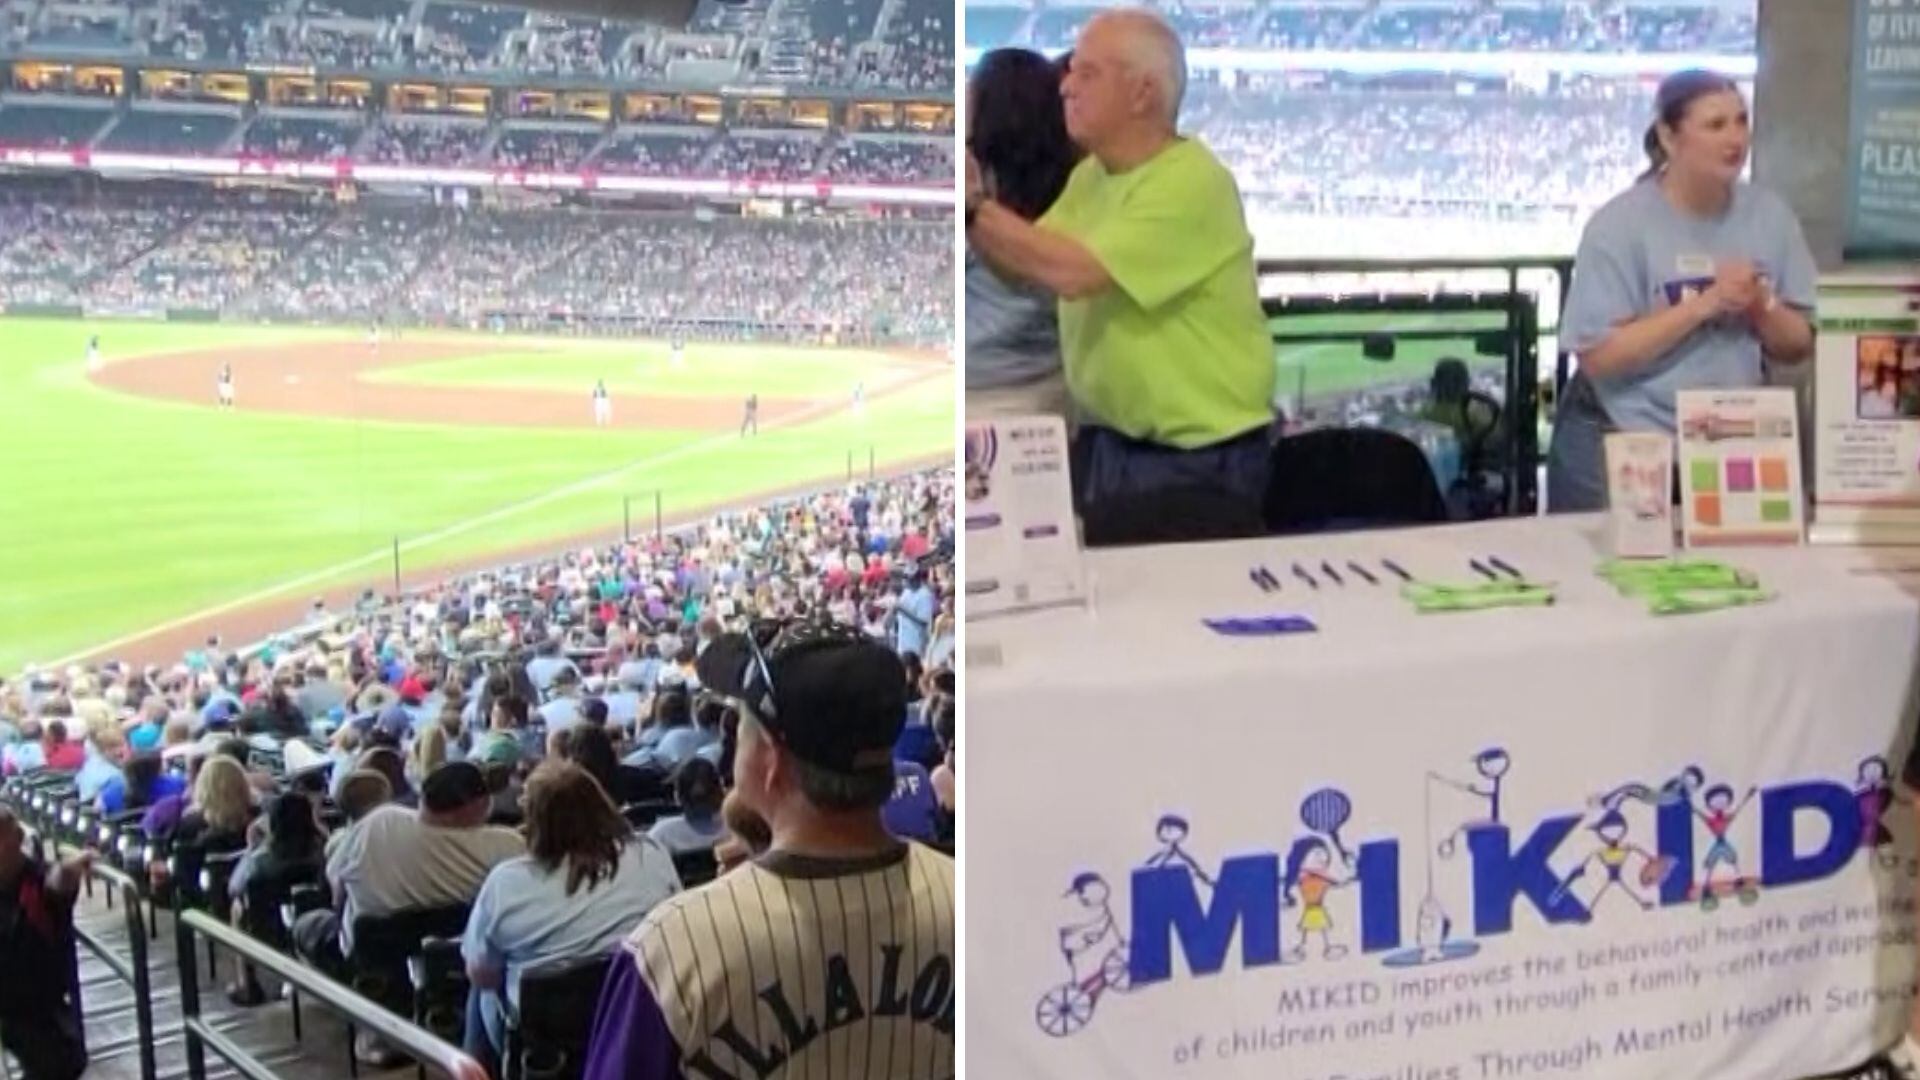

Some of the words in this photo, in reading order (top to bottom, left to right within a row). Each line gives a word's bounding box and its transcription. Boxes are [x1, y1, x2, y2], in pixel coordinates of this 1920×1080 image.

[890, 774, 920, 800] PF
[1129, 779, 1866, 990] MIKID
[1278, 981, 1381, 1015] MIKID
[1392, 963, 1514, 999] improves
[1524, 956, 1566, 980] the
[1576, 927, 1707, 971] behavioral
[1715, 914, 1790, 944] health
[1798, 904, 1837, 932] and
[684, 944, 955, 1080] ILLALO
[1173, 1034, 1203, 1064] of
[1217, 1022, 1336, 1059] children
[1345, 1012, 1395, 1041] and
[1405, 1001, 1483, 1038] youth
[1494, 980, 1596, 1019] through
[1605, 980, 1620, 997] a
[1475, 1036, 1602, 1079] Through
[1613, 1010, 1712, 1057] Mental
[1723, 988, 1812, 1032] Health
